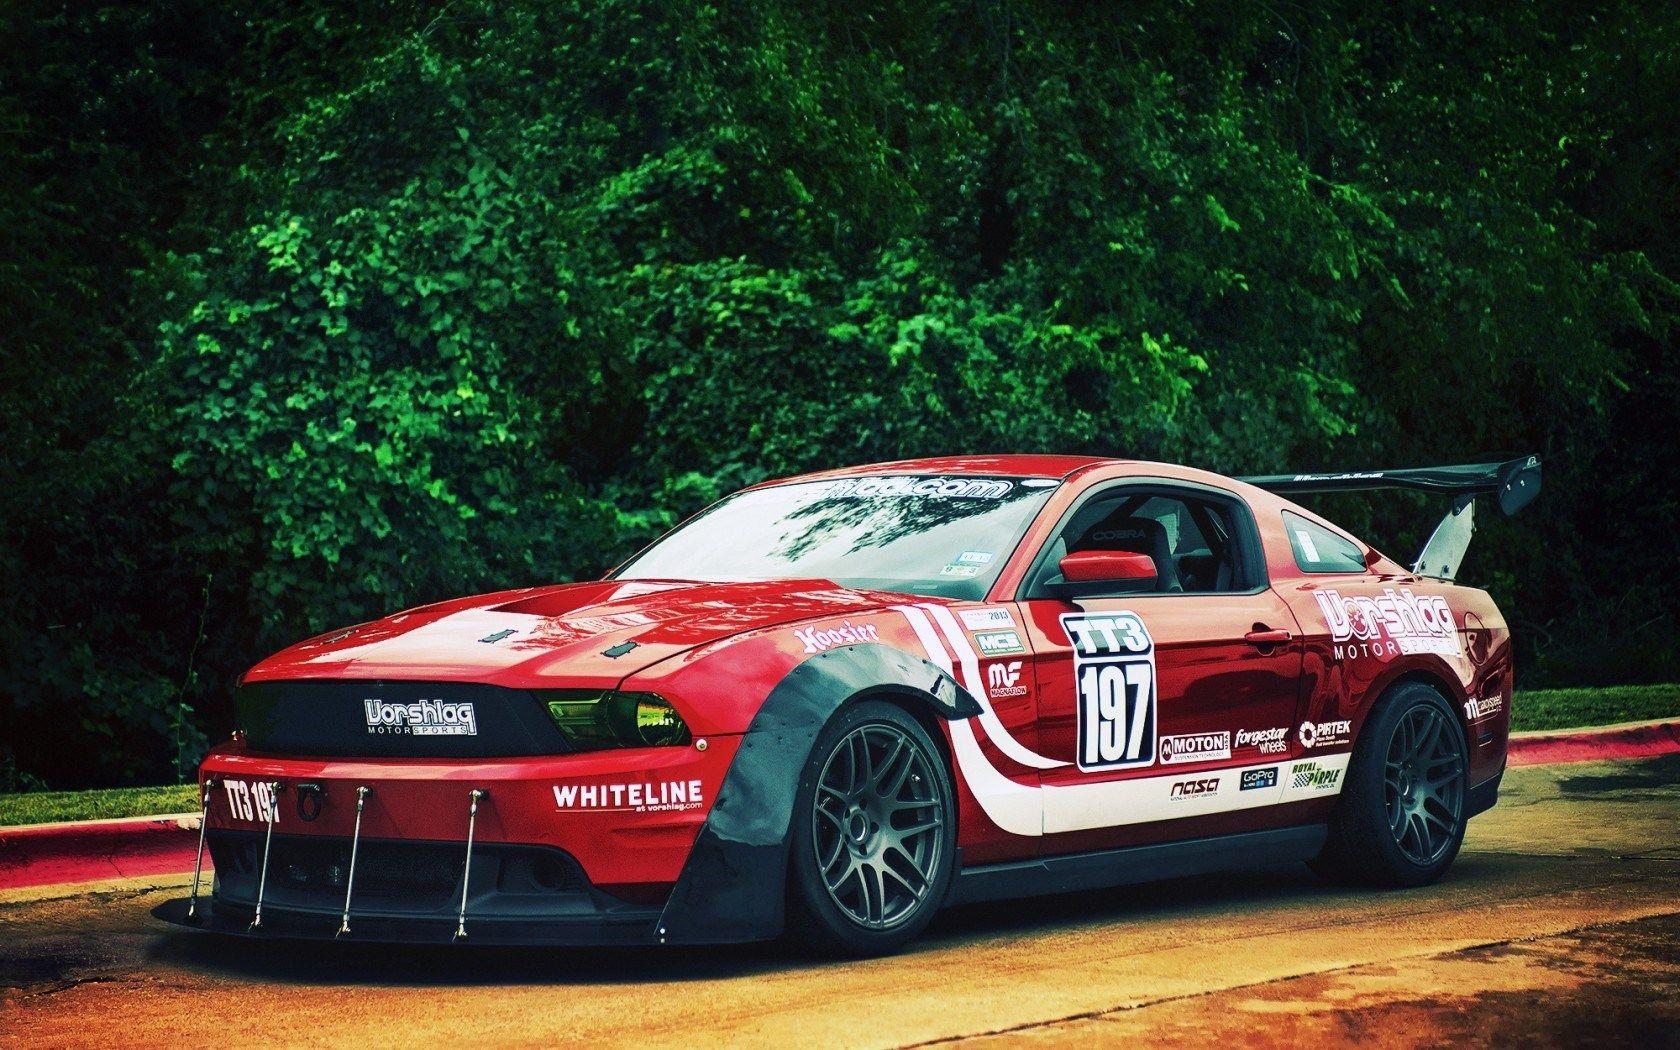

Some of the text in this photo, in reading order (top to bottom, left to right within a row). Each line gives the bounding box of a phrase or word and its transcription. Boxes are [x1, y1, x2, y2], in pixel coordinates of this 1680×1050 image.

[1092, 528, 1146, 541] COBRA
[988, 611, 1009, 620] 2013
[1312, 588, 1463, 658] Vorshlag
[793, 618, 879, 654] Hoosier
[1065, 618, 1150, 654] TT3
[991, 686, 1027, 697] MAGNAFLOW
[364, 699, 477, 735] Vorshlag
[1081, 664, 1152, 764] 197
[368, 726, 468, 736] MOTORSPORTS
[1316, 720, 1351, 737] PIRTEK
[1174, 735, 1224, 754] MOTON
[1235, 728, 1289, 748] forgestar
[1259, 740, 1286, 754] wheels
[1243, 770, 1274, 782] GoPro
[1292, 762, 1317, 774] ROYAL
[223, 779, 254, 822] TT3
[553, 779, 703, 808] WHITELINE
[635, 802, 703, 813] at vorshlag.com
